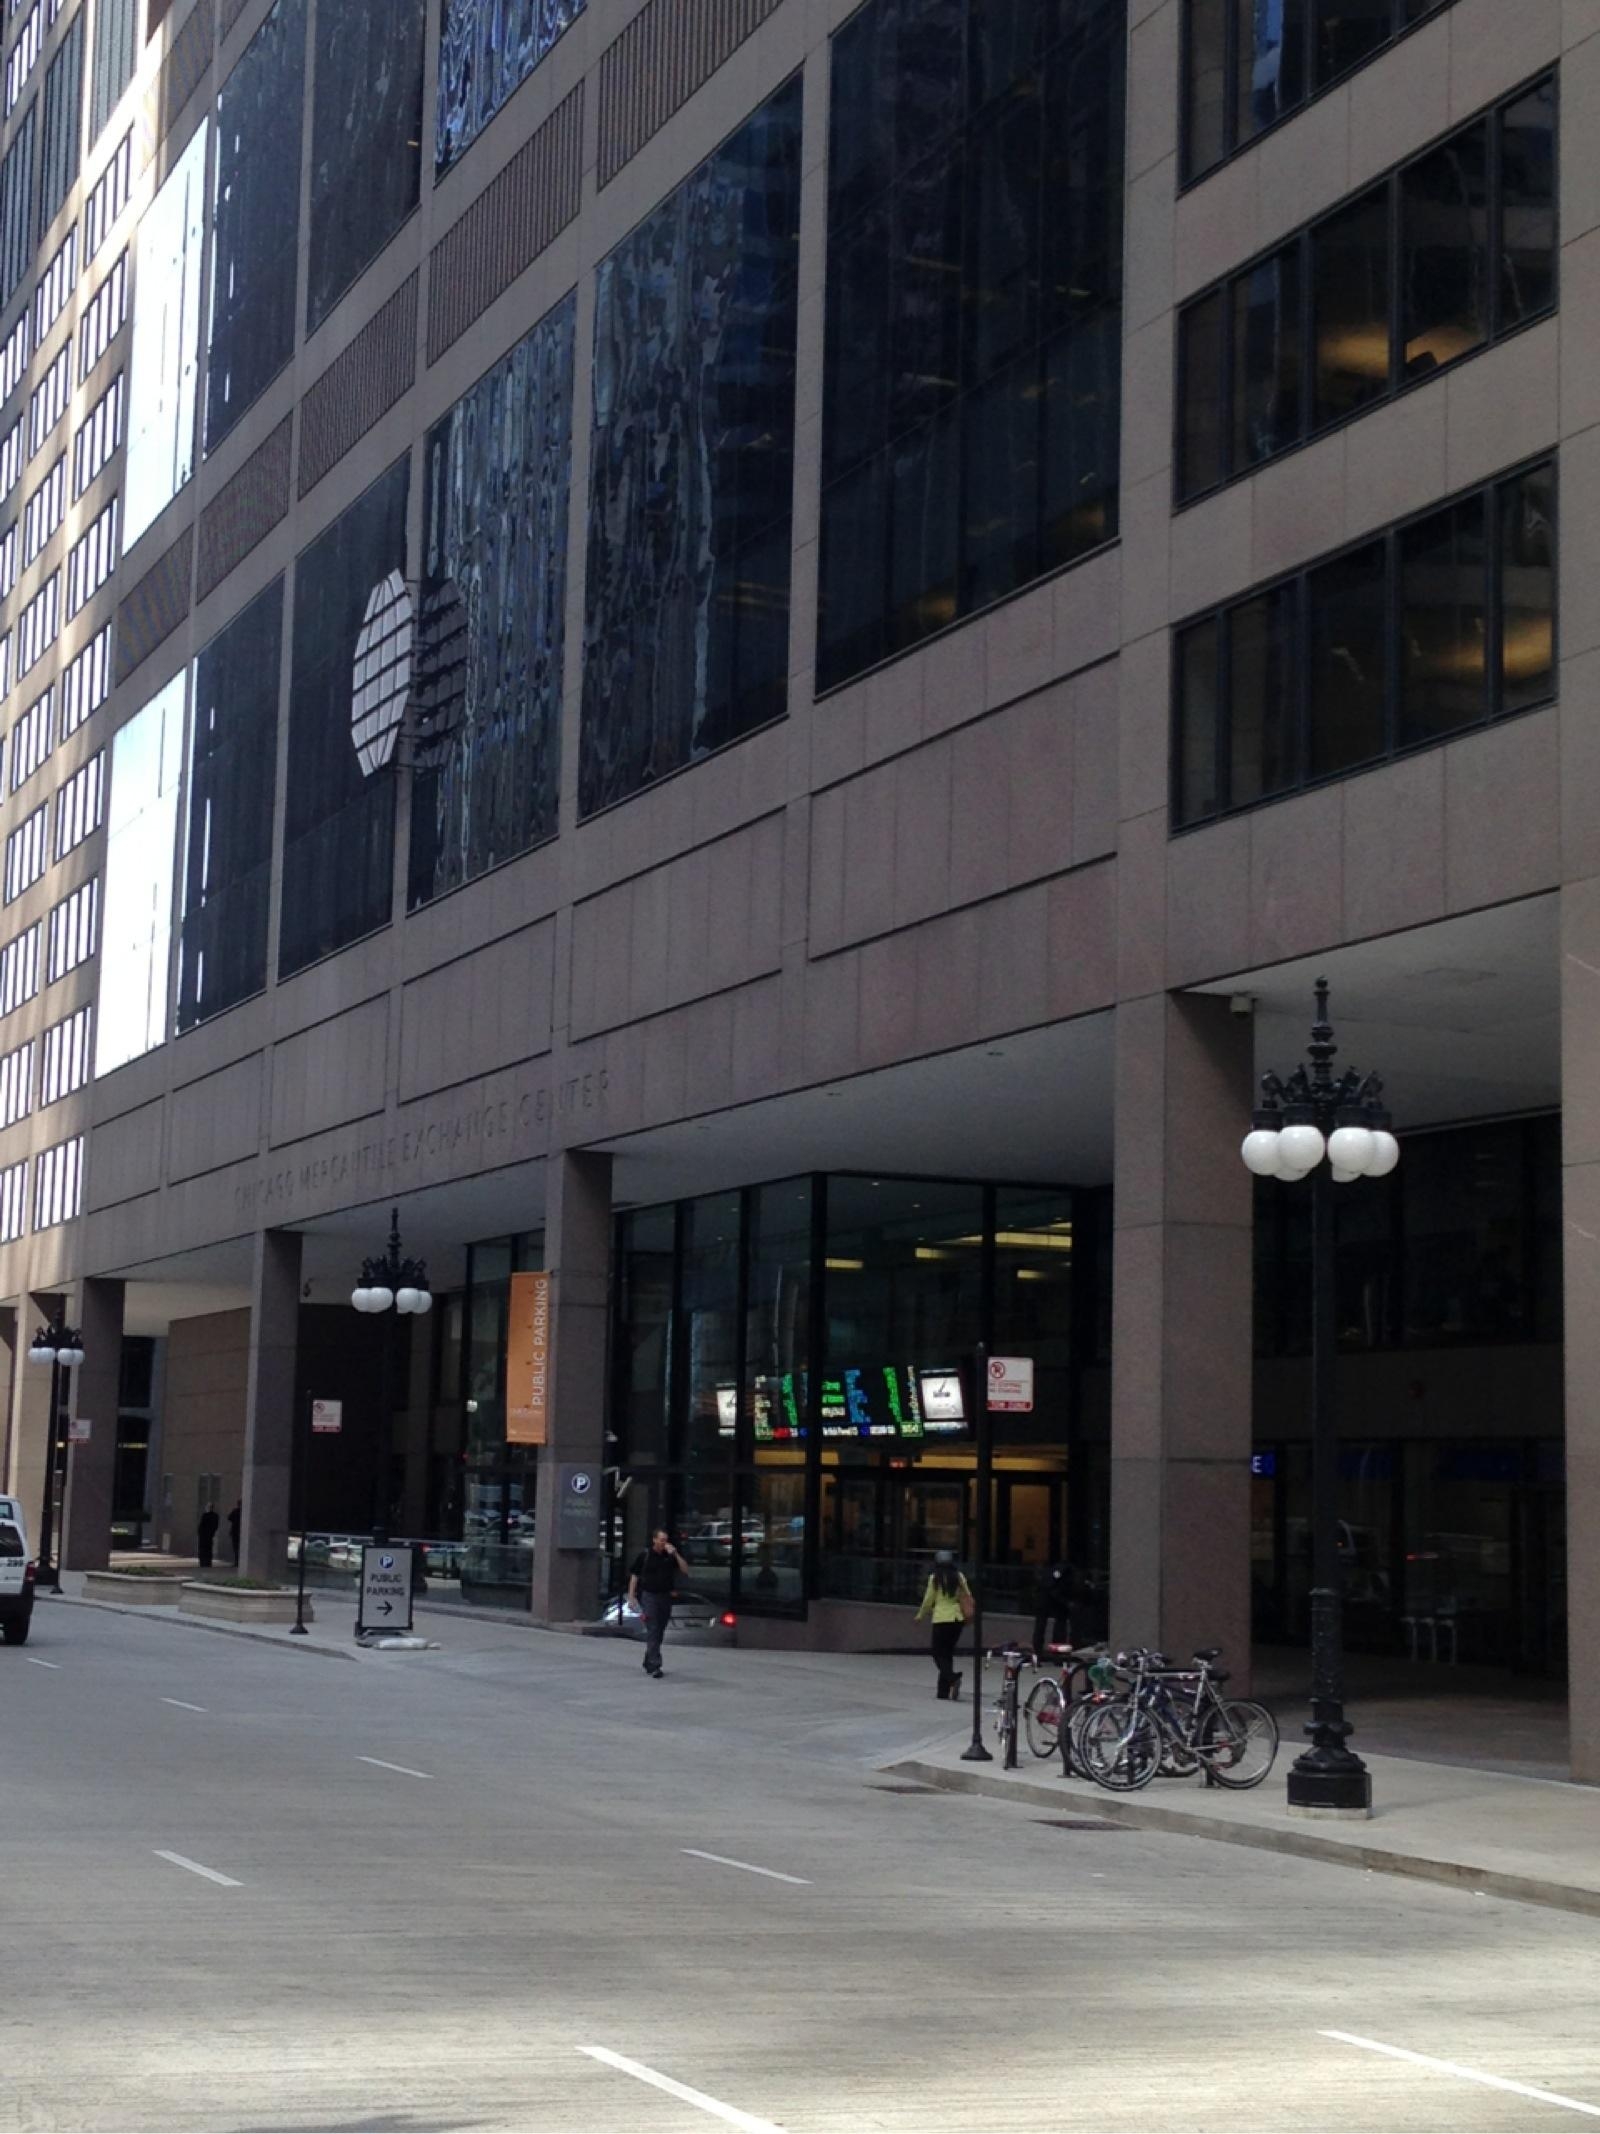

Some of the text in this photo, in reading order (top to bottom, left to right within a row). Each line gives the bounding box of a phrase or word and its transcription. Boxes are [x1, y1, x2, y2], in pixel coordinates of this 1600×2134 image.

[532, 1279, 549, 1406] PUBLIC PARKING
[371, 1573, 403, 1583] PUBLIC
[366, 1586, 405, 1597] PARKING
